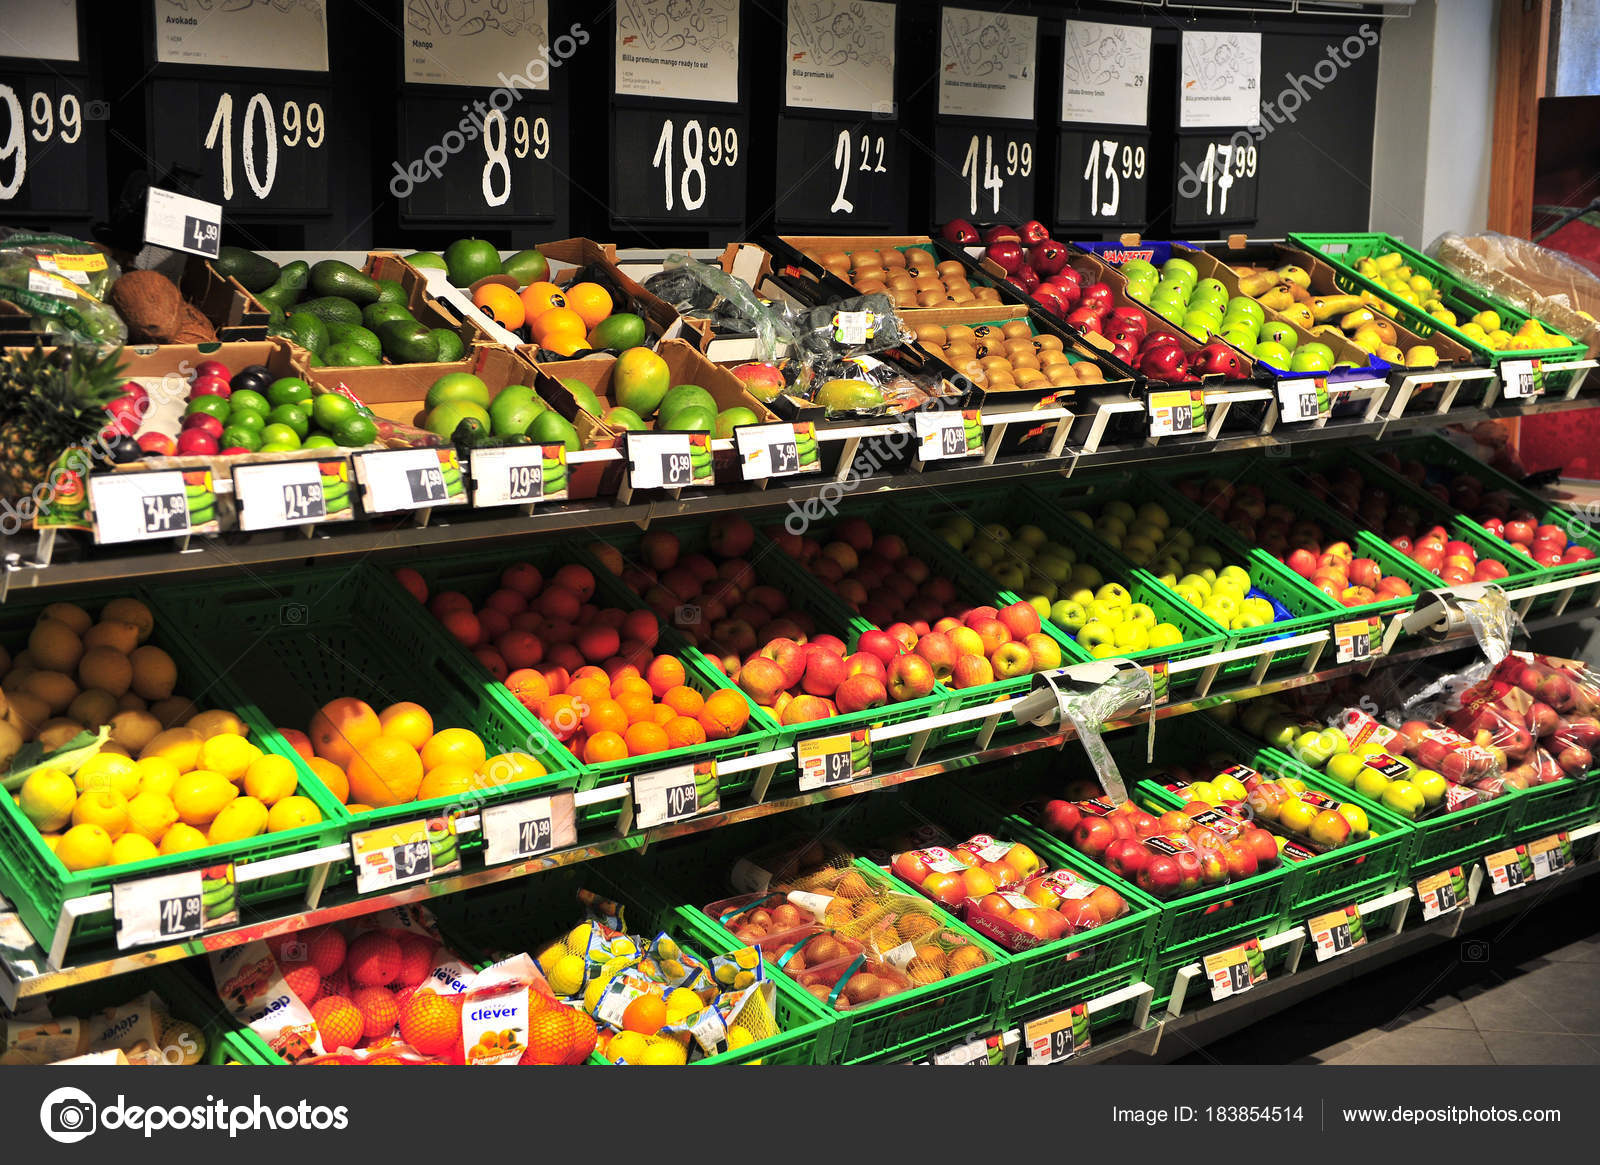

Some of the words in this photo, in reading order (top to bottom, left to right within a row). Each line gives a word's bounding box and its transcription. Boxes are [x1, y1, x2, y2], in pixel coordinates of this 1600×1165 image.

[166, 15, 198, 26] Avokado
[635, 56, 660, 65] premium
[660, 58, 677, 67] mango
[678, 60, 693, 69] ready
[804, 71, 826, 79] premium
[1133, 75, 1144, 87] 29
[249, 995, 291, 1025] clever
[471, 1006, 519, 1022] clever
[103, 1012, 140, 1042] clever
